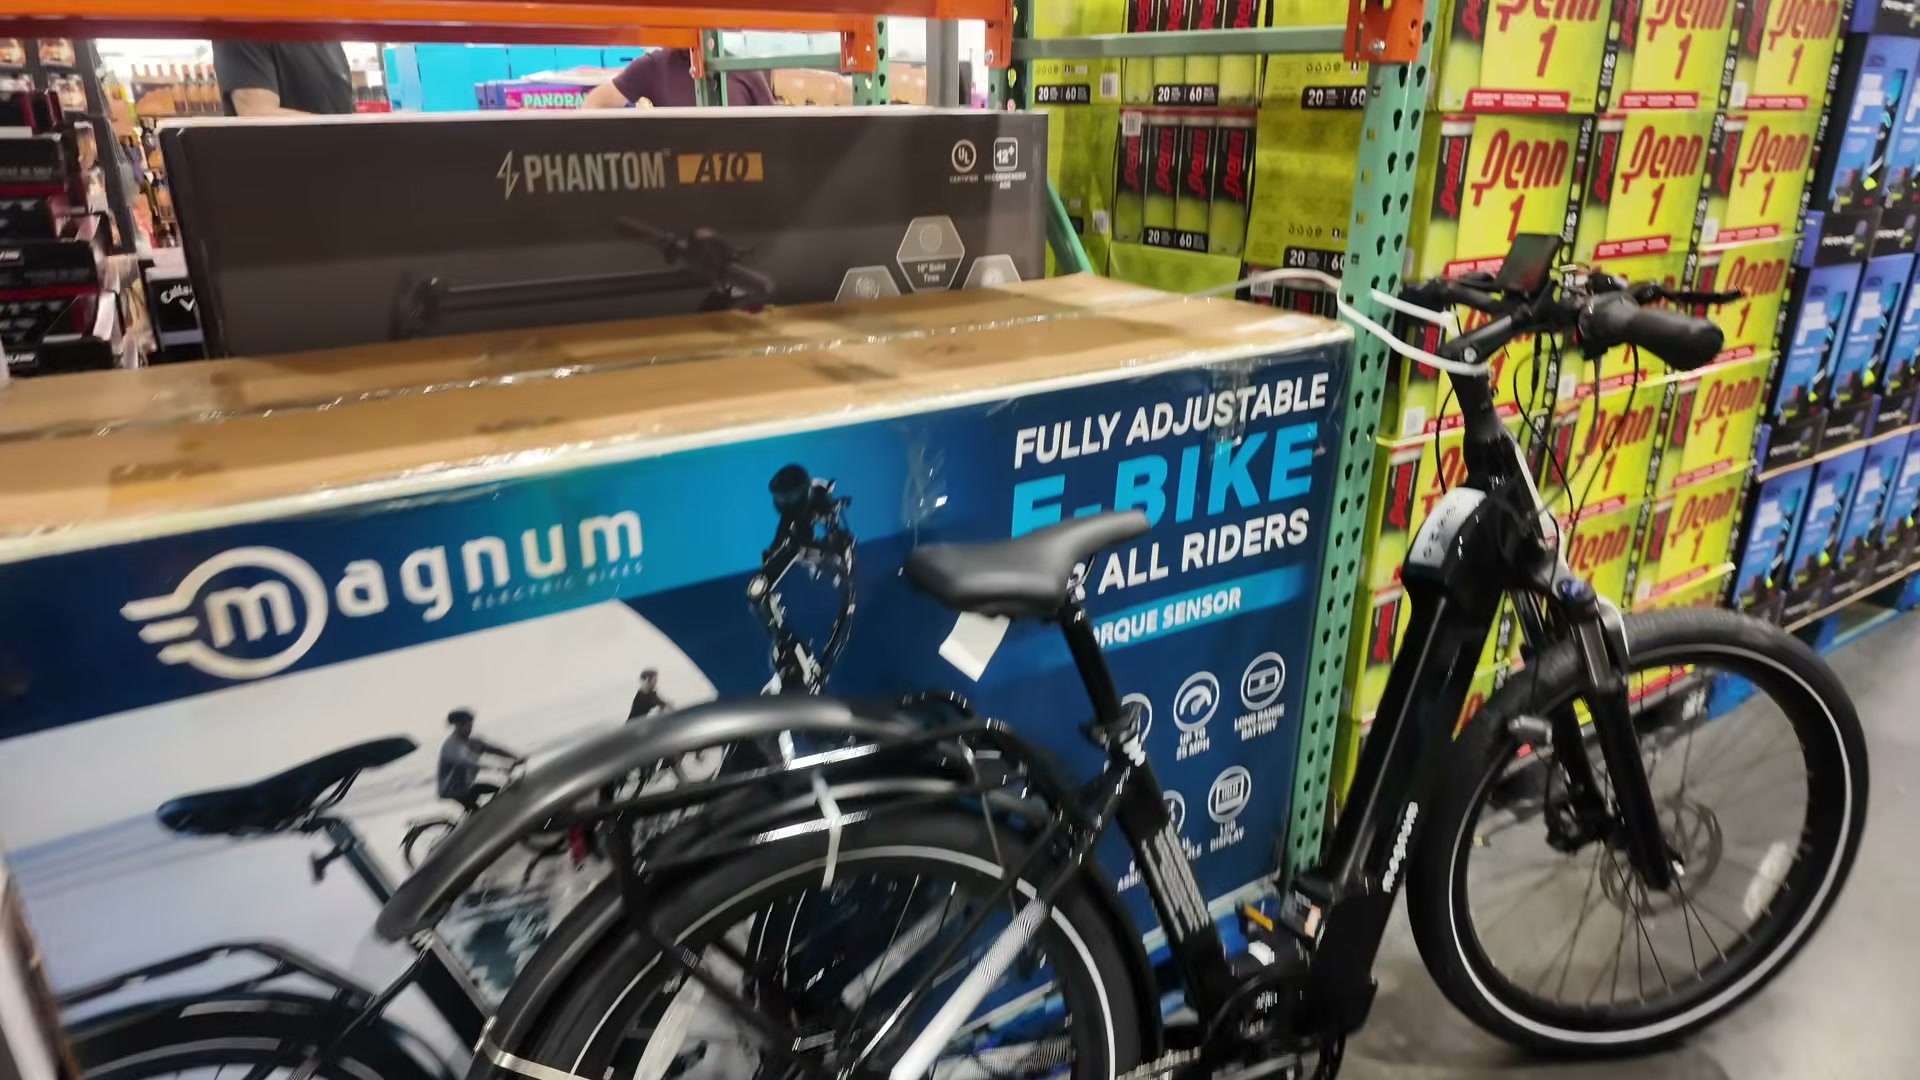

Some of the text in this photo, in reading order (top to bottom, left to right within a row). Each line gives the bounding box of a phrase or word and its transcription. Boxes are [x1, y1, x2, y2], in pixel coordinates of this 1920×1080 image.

[1538, 24, 1558, 78] 1
[1674, 33, 1693, 80] 1
[1787, 43, 1804, 85] 1
[1038, 86, 1049, 101] 20
[1065, 86, 1077, 101] 60
[1157, 86, 1170, 102] 20
[1189, 86, 1203, 102] 60
[1307, 87, 1367, 107] 20 60
[523, 151, 751, 193] PHANTOM A10
[1470, 129, 1570, 207] Penn
[1619, 125, 1704, 194] Penn
[1739, 125, 1809, 188] Penn
[1507, 193, 1525, 243] 1
[1647, 182, 1666, 226] 1
[1760, 177, 1776, 217] 1
[1147, 229, 1193, 248] 20 60
[1288, 248, 1306, 267] 20
[1736, 302, 1752, 338] 1
[1014, 372, 1330, 470] FULLY ADJUSTABLE
[1694, 376, 1761, 436] Penn
[1714, 419, 1728, 455] 1
[1601, 453, 1617, 492] 1
[1669, 486, 1737, 549] Penn
[1097, 541, 1170, 596] ALL
[1180, 507, 1310, 573] RIDERS
[1691, 529, 1705, 563] 1
[1162, 586, 1242, 630] SENSOR
